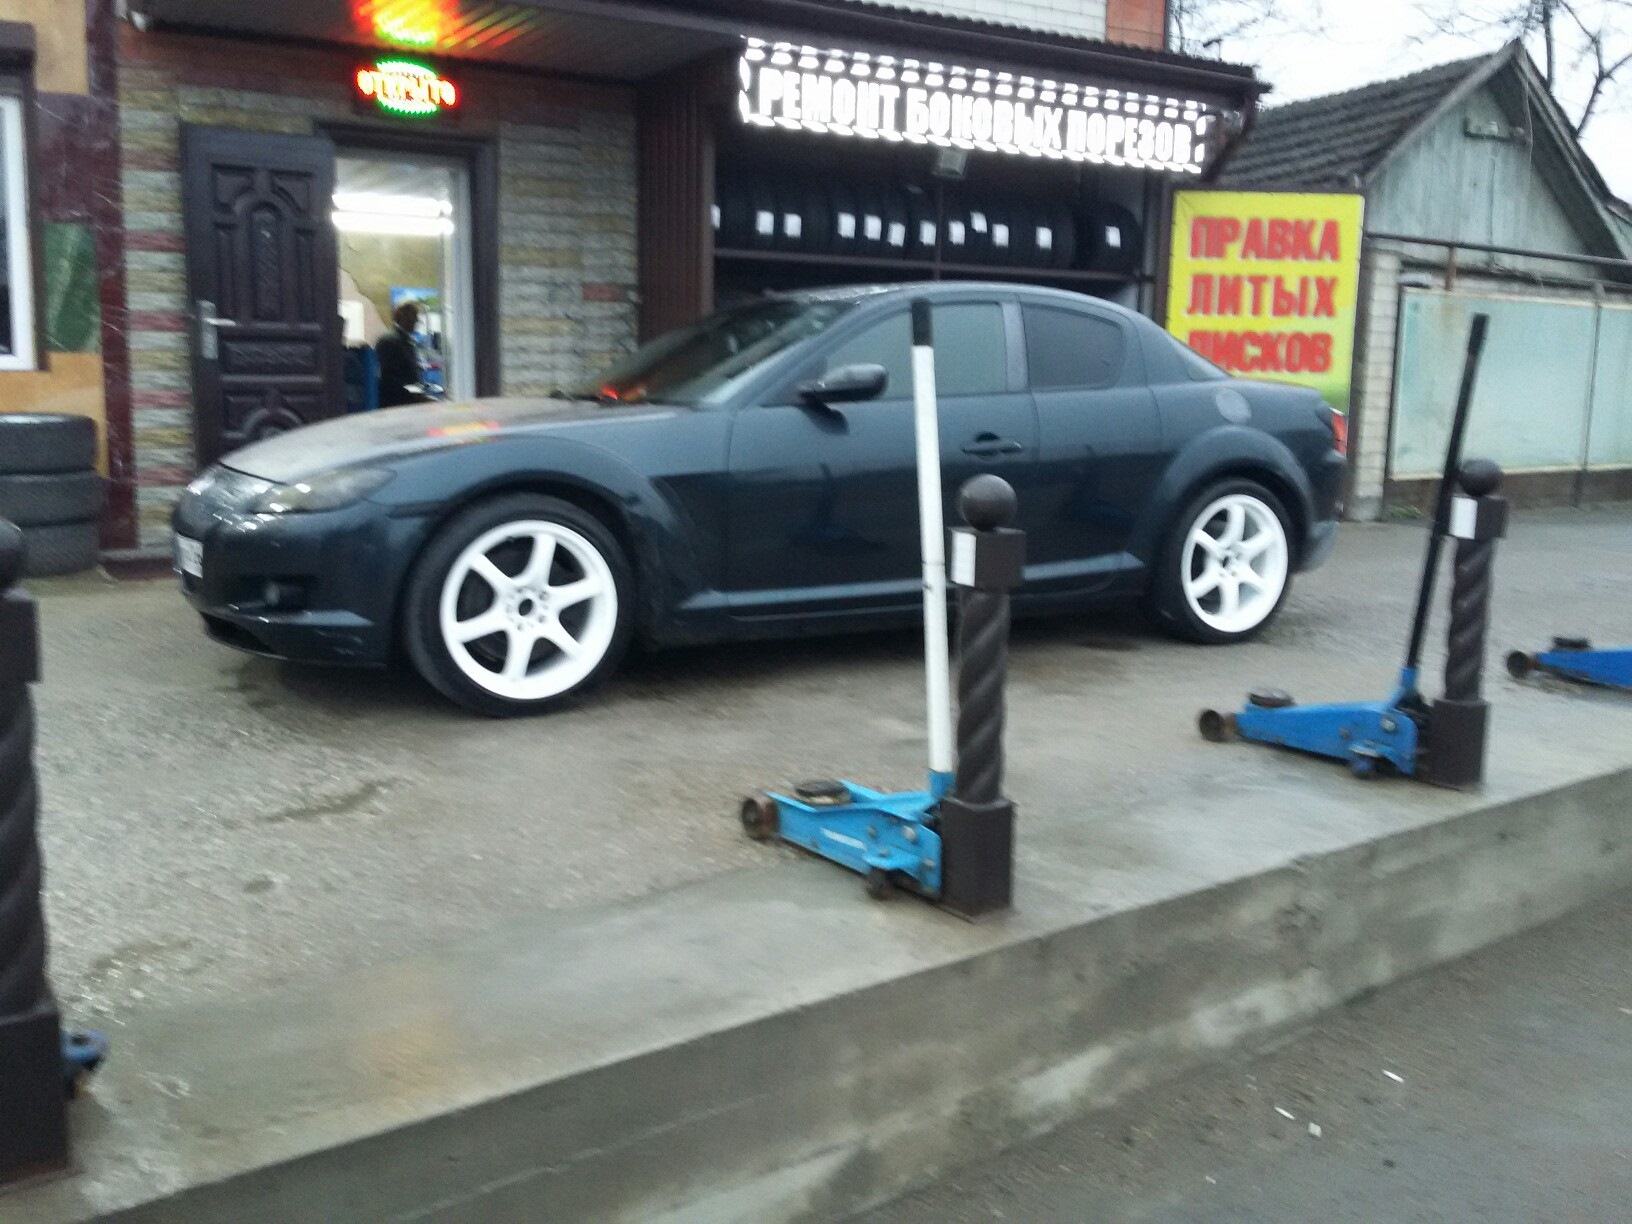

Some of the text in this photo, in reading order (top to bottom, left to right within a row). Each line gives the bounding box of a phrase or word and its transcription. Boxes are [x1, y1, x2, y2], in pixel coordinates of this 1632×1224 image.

[759, 68, 1192, 164] РЕМОНТ БОКОВЫХ ПОРЕЗОВ
[1190, 216, 1340, 262] ПРАВКА
[1186, 273, 1338, 318] ЛИТЫХ
